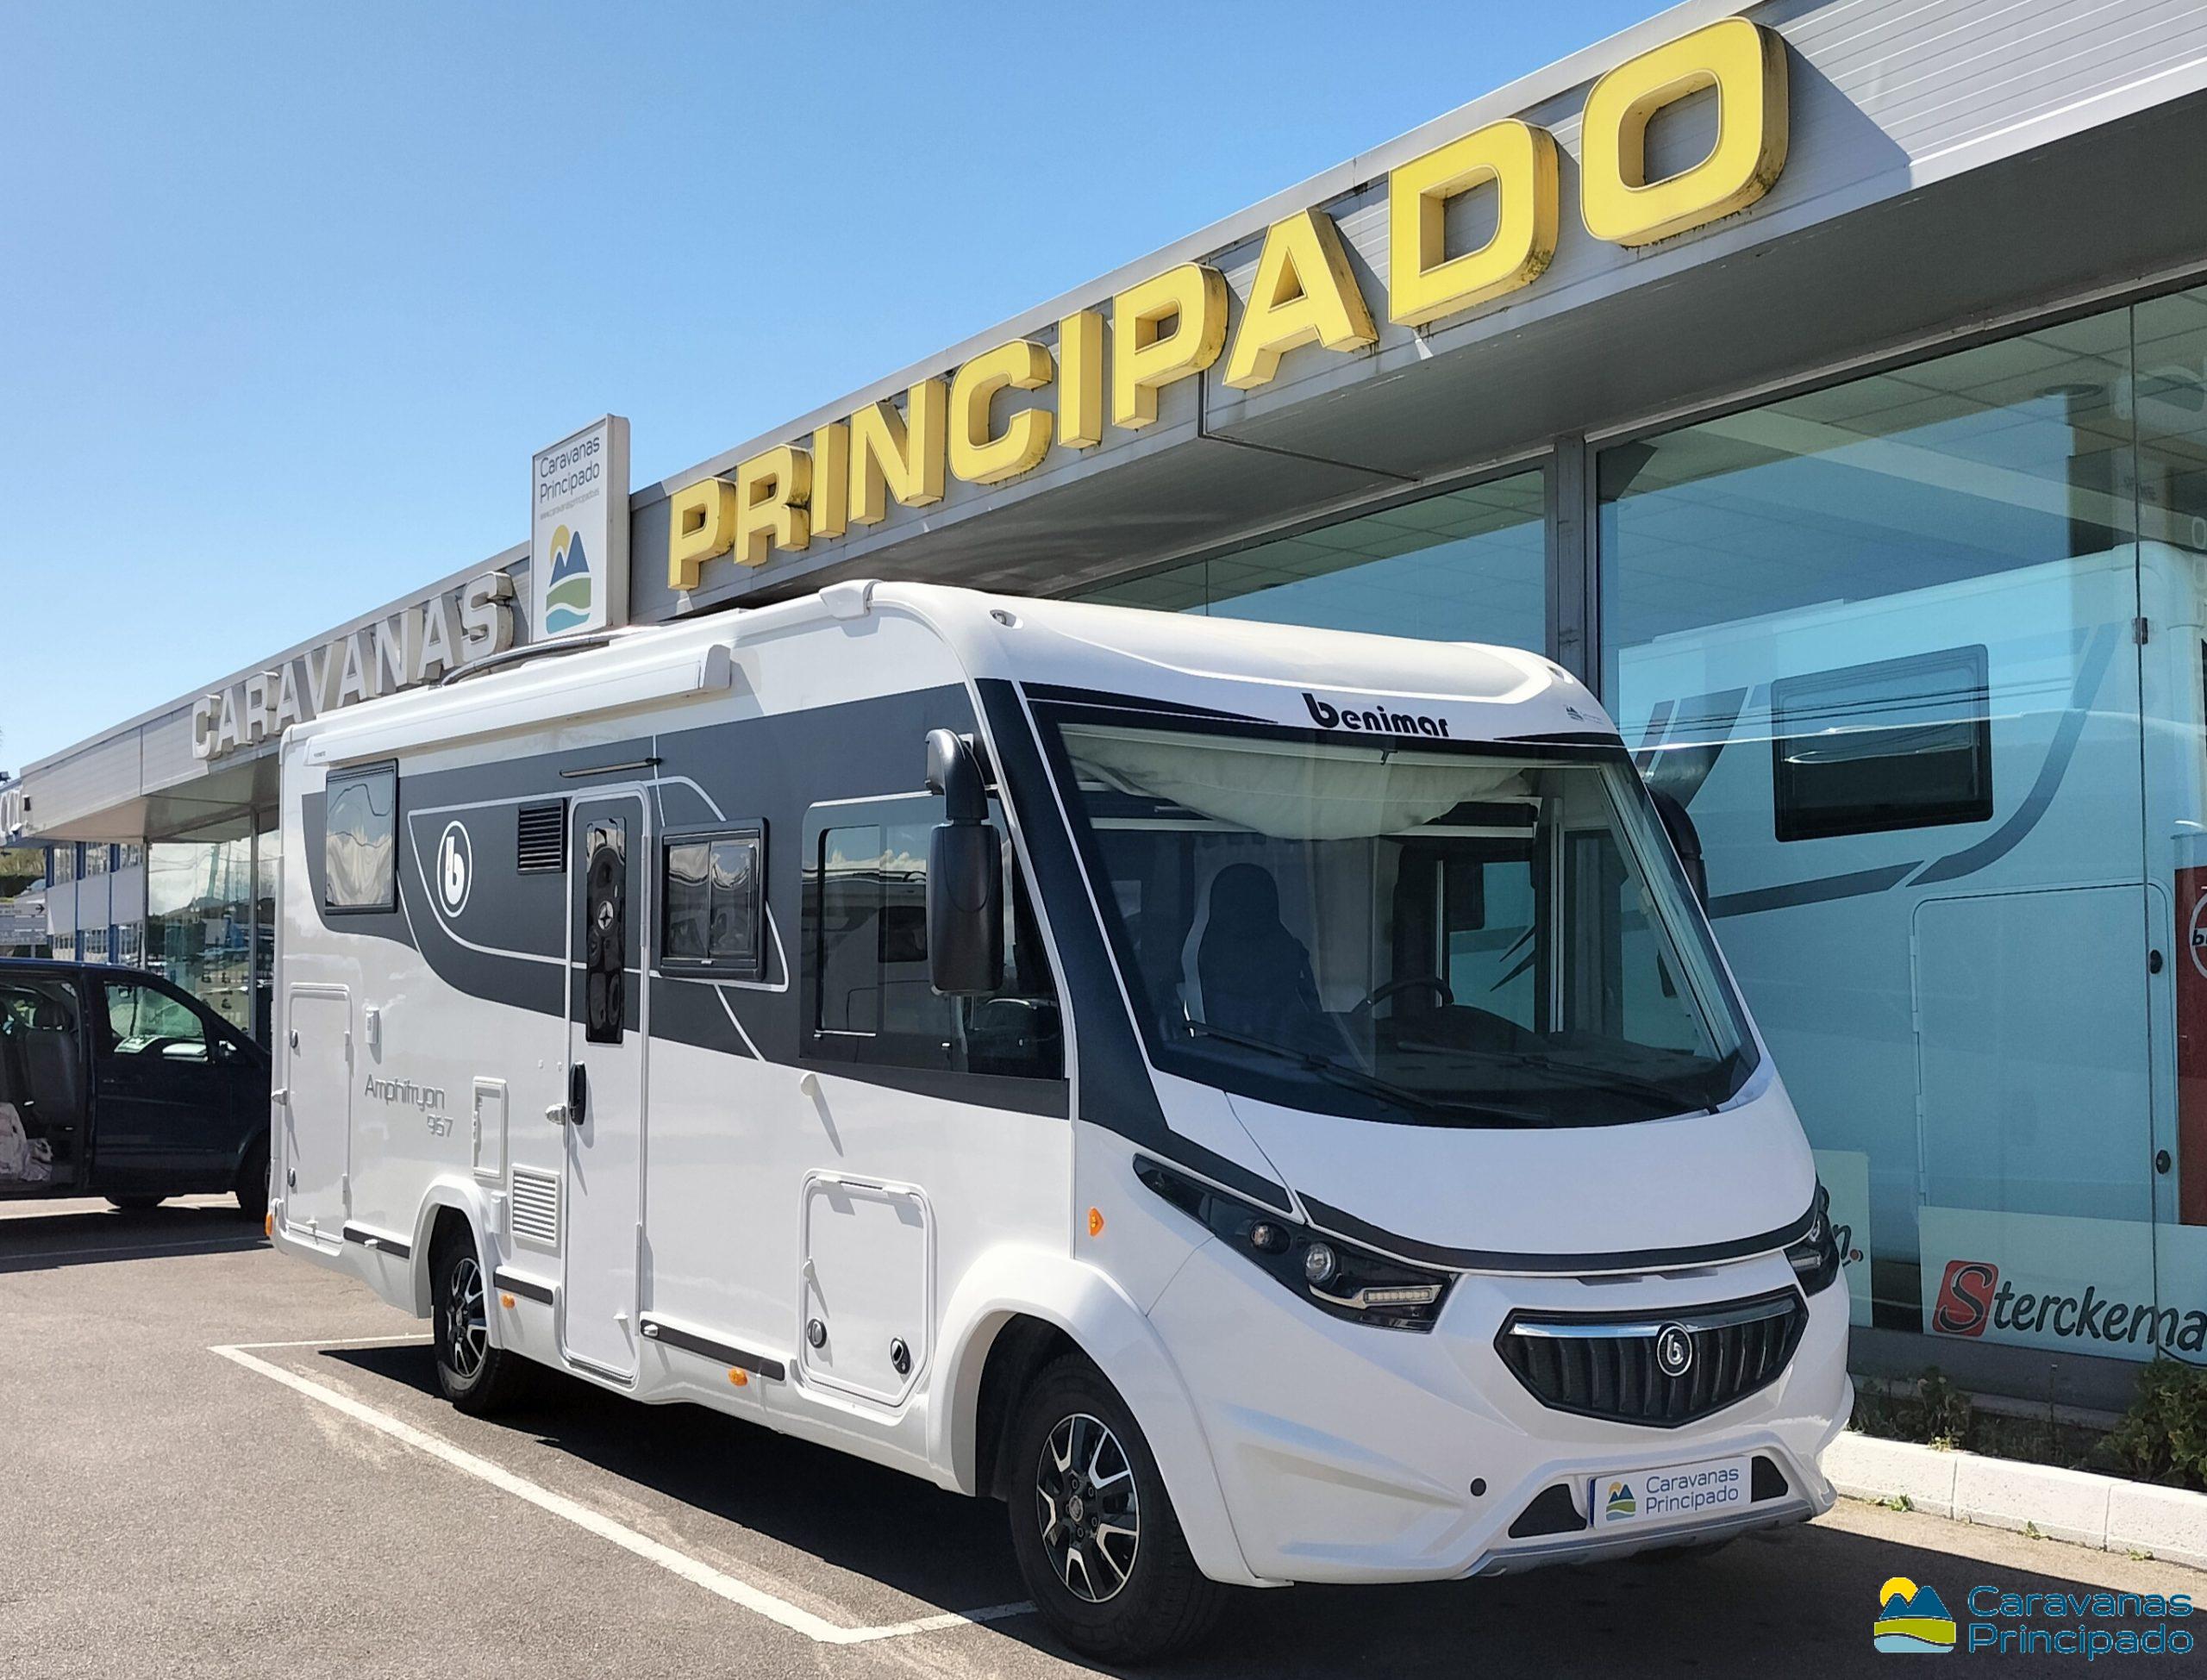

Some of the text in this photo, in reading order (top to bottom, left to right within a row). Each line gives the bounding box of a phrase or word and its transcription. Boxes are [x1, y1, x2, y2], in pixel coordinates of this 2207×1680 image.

[668, 16, 1789, 591] PRINCIPADO
[540, 436, 600, 478] Caravanas
[540, 460, 600, 503] Principado
[192, 571, 514, 760] CARAVANAS
[1302, 692, 1449, 737] benimar
[365, 1074, 445, 1112] Amphitryon
[1646, 1468, 1740, 1494] Caravanas
[1646, 1485, 1740, 1514] Principado
